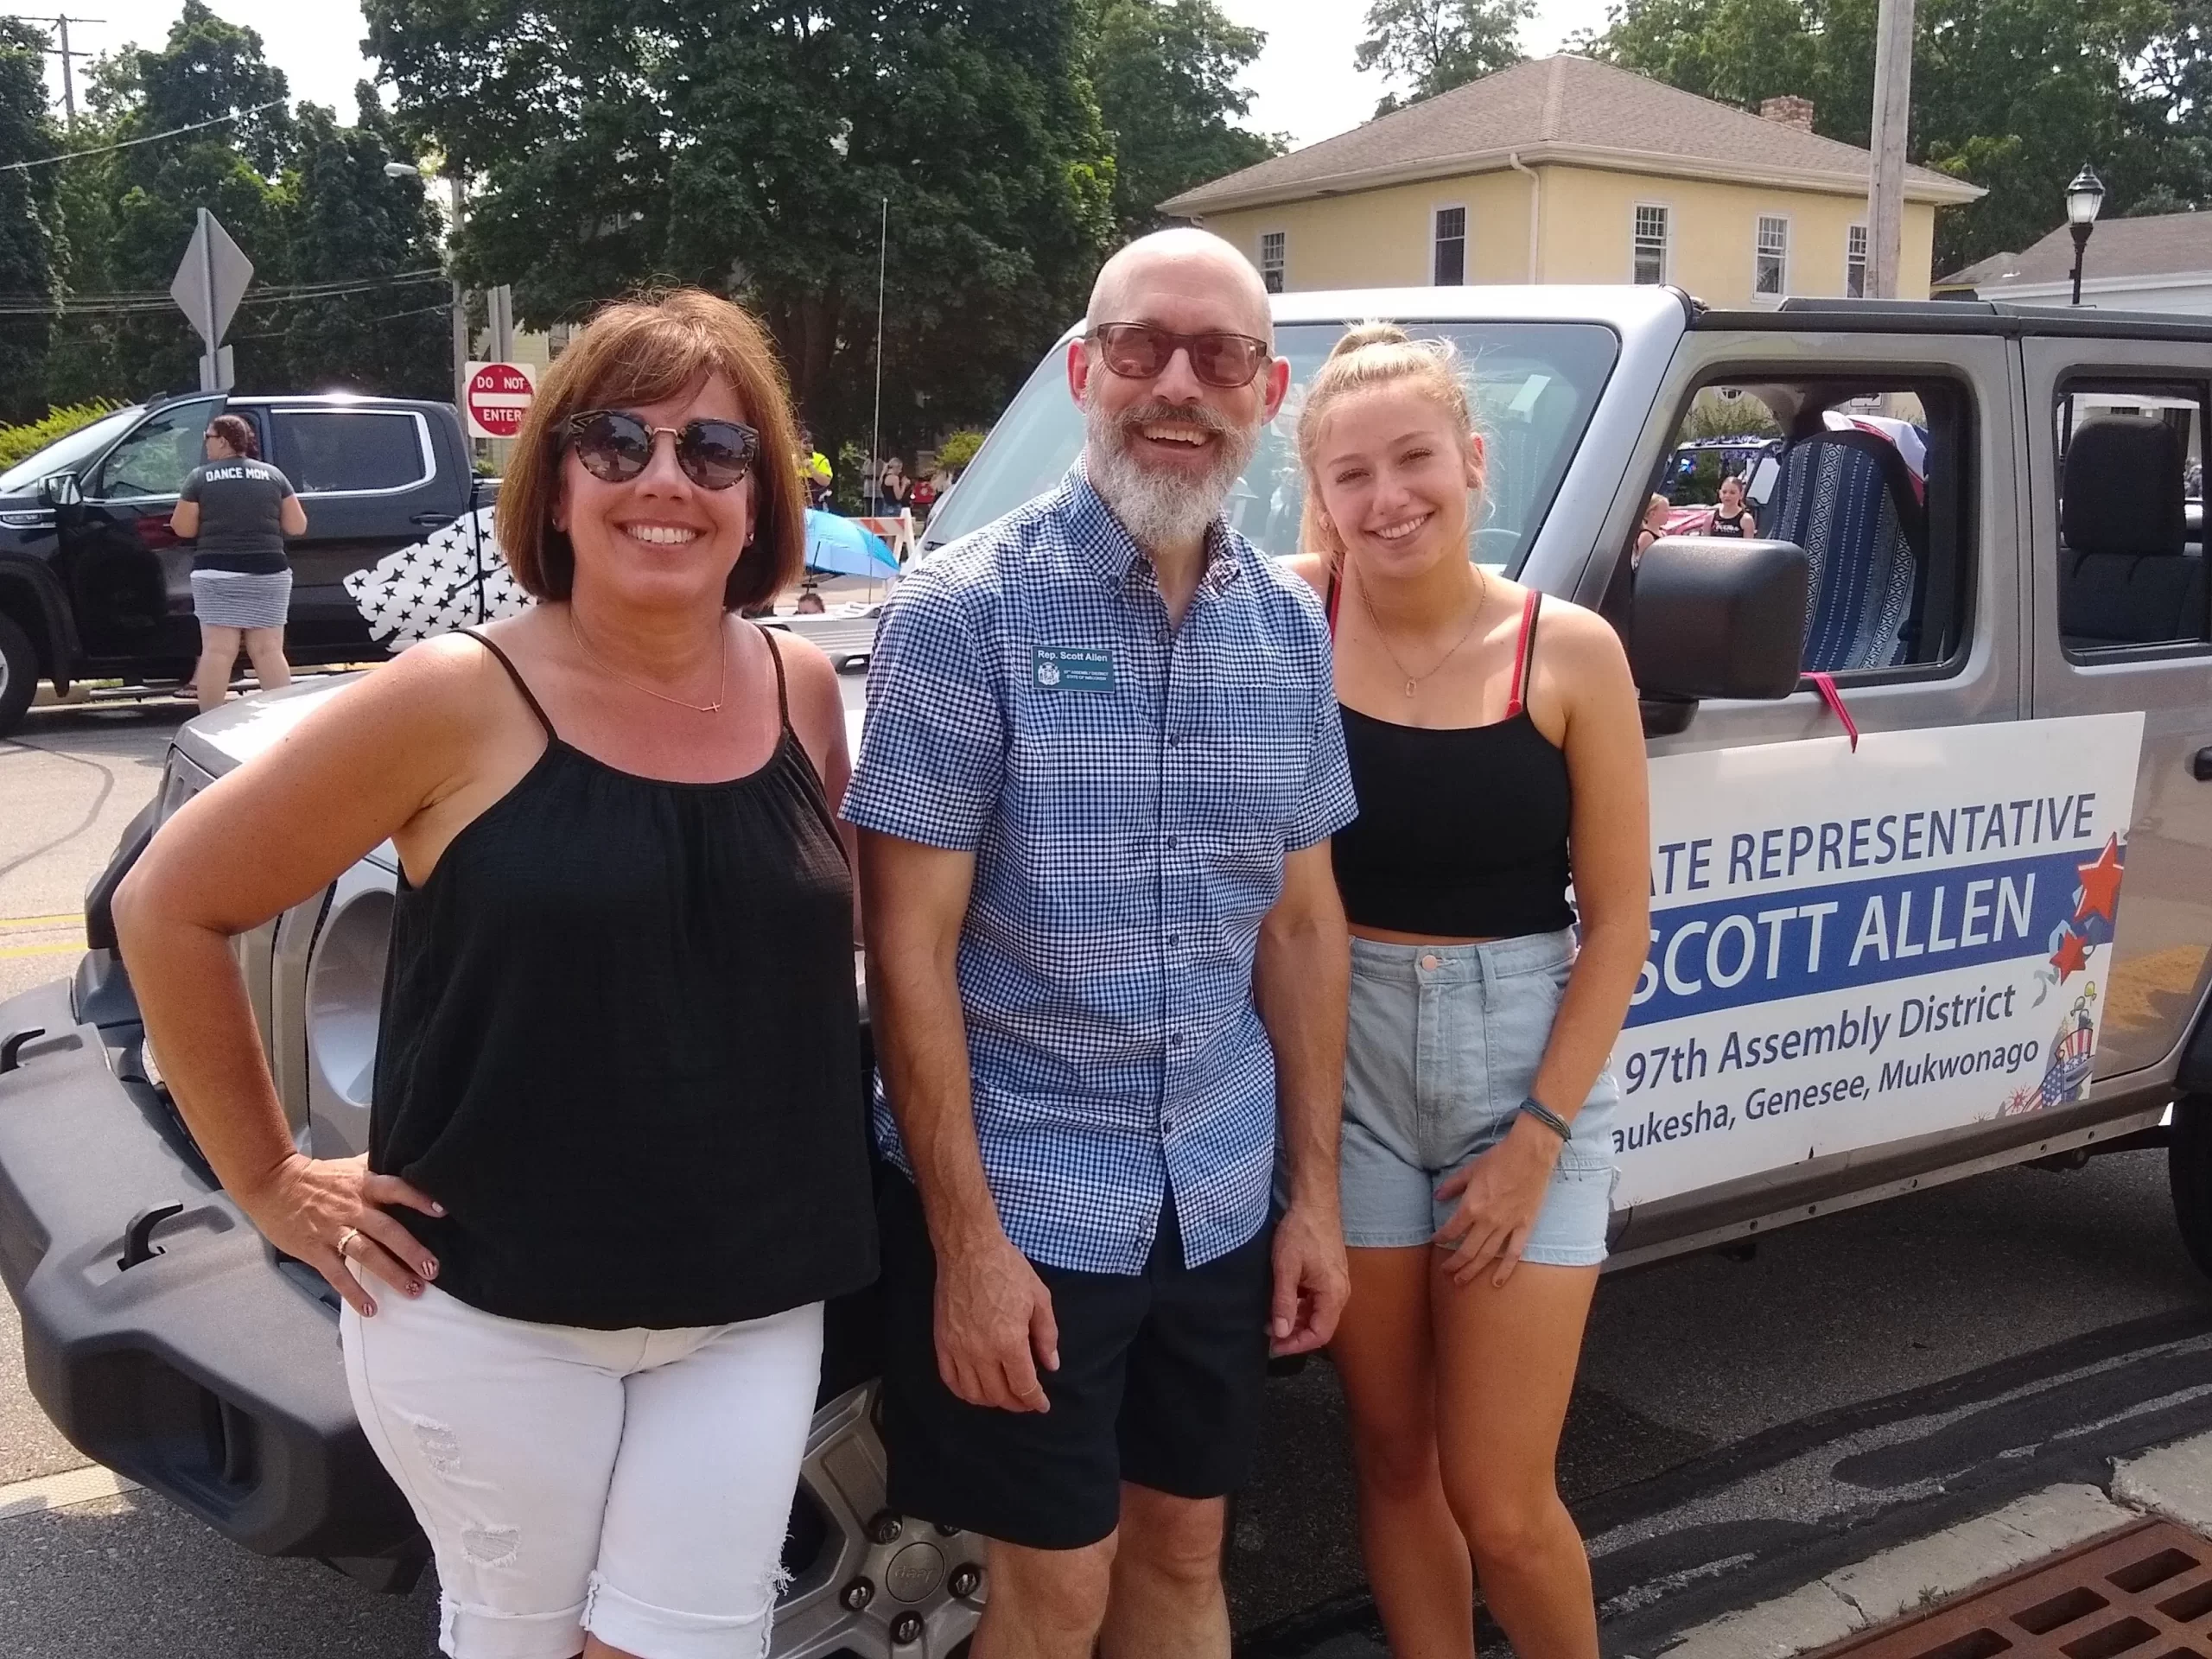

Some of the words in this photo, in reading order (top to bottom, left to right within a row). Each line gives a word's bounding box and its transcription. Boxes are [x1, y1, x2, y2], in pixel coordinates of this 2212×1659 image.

[477, 377, 493, 389] DO
[504, 377, 524, 389] NOT
[483, 409, 522, 422] ENTER
[206, 467, 243, 482] DANCE
[245, 467, 270, 480] MOM
[1037, 650, 1058, 661] Rep.
[1059, 651, 1084, 660] Scott
[1084, 652, 1108, 662] Allen
[1728, 792, 2096, 885] REPRESENTATIVE
[1847, 873, 2037, 968] ALLEN
[1625, 1037, 1708, 1095] 97th
[1717, 1005, 1892, 1074] Assembly
[1898, 984, 2016, 1039] District
[1745, 1074, 1871, 1121] Genesee,
[1878, 1039, 2040, 1093] Mukwonago
